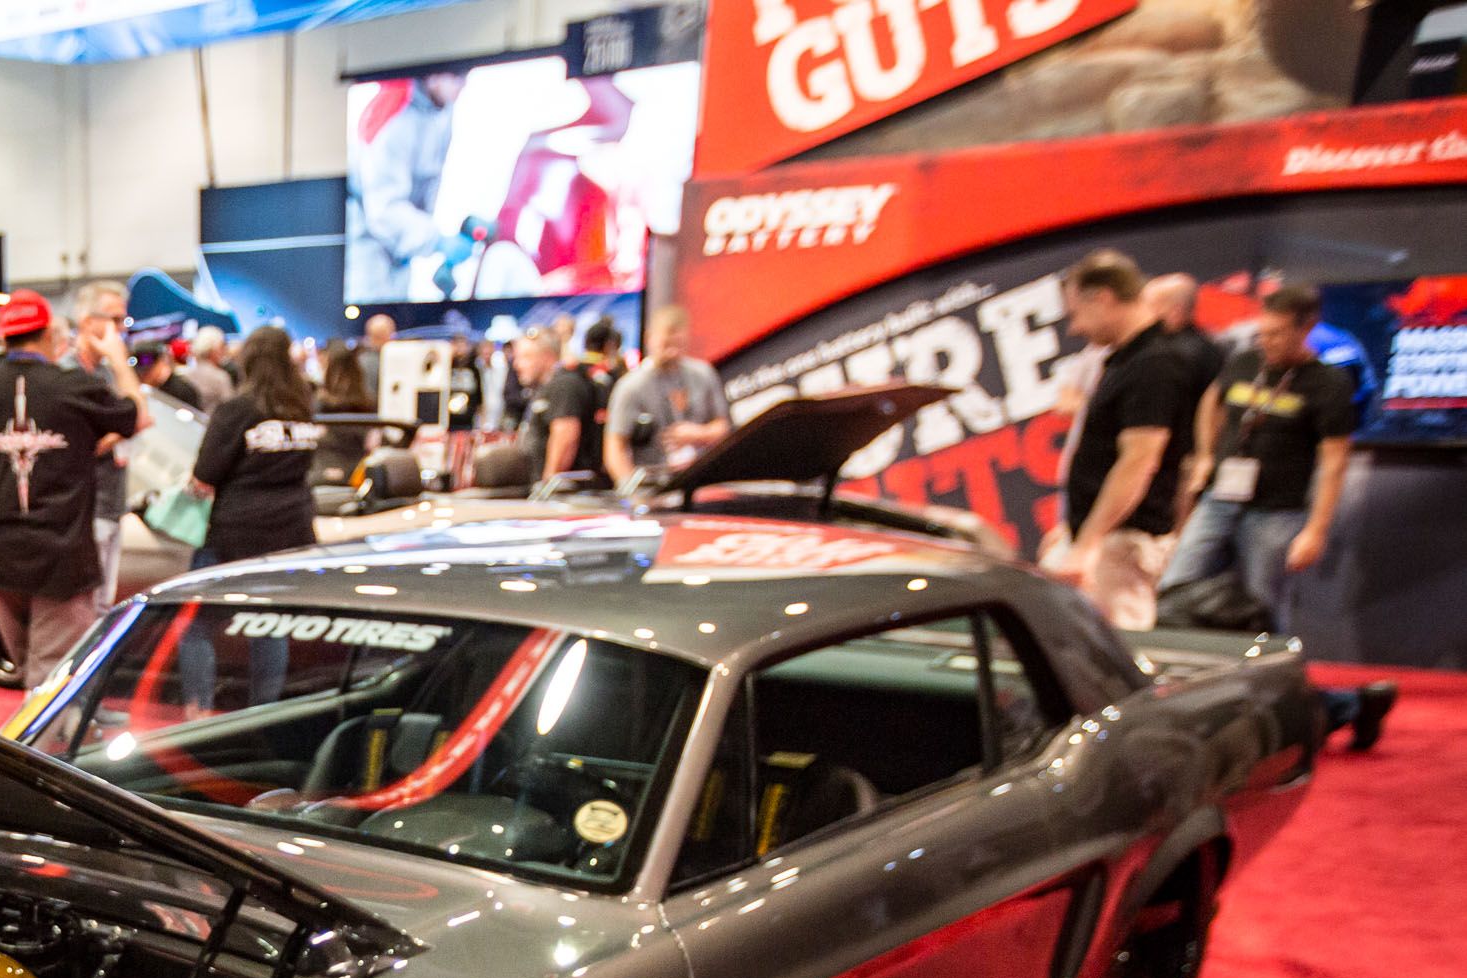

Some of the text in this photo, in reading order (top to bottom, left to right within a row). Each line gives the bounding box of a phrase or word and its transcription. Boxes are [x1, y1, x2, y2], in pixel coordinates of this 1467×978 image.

[1280, 141, 1428, 177] Discover
[703, 182, 899, 237] ODYSSEY
[702, 223, 876, 257] BATTERY
[224, 611, 441, 652] TOYO TIRES
